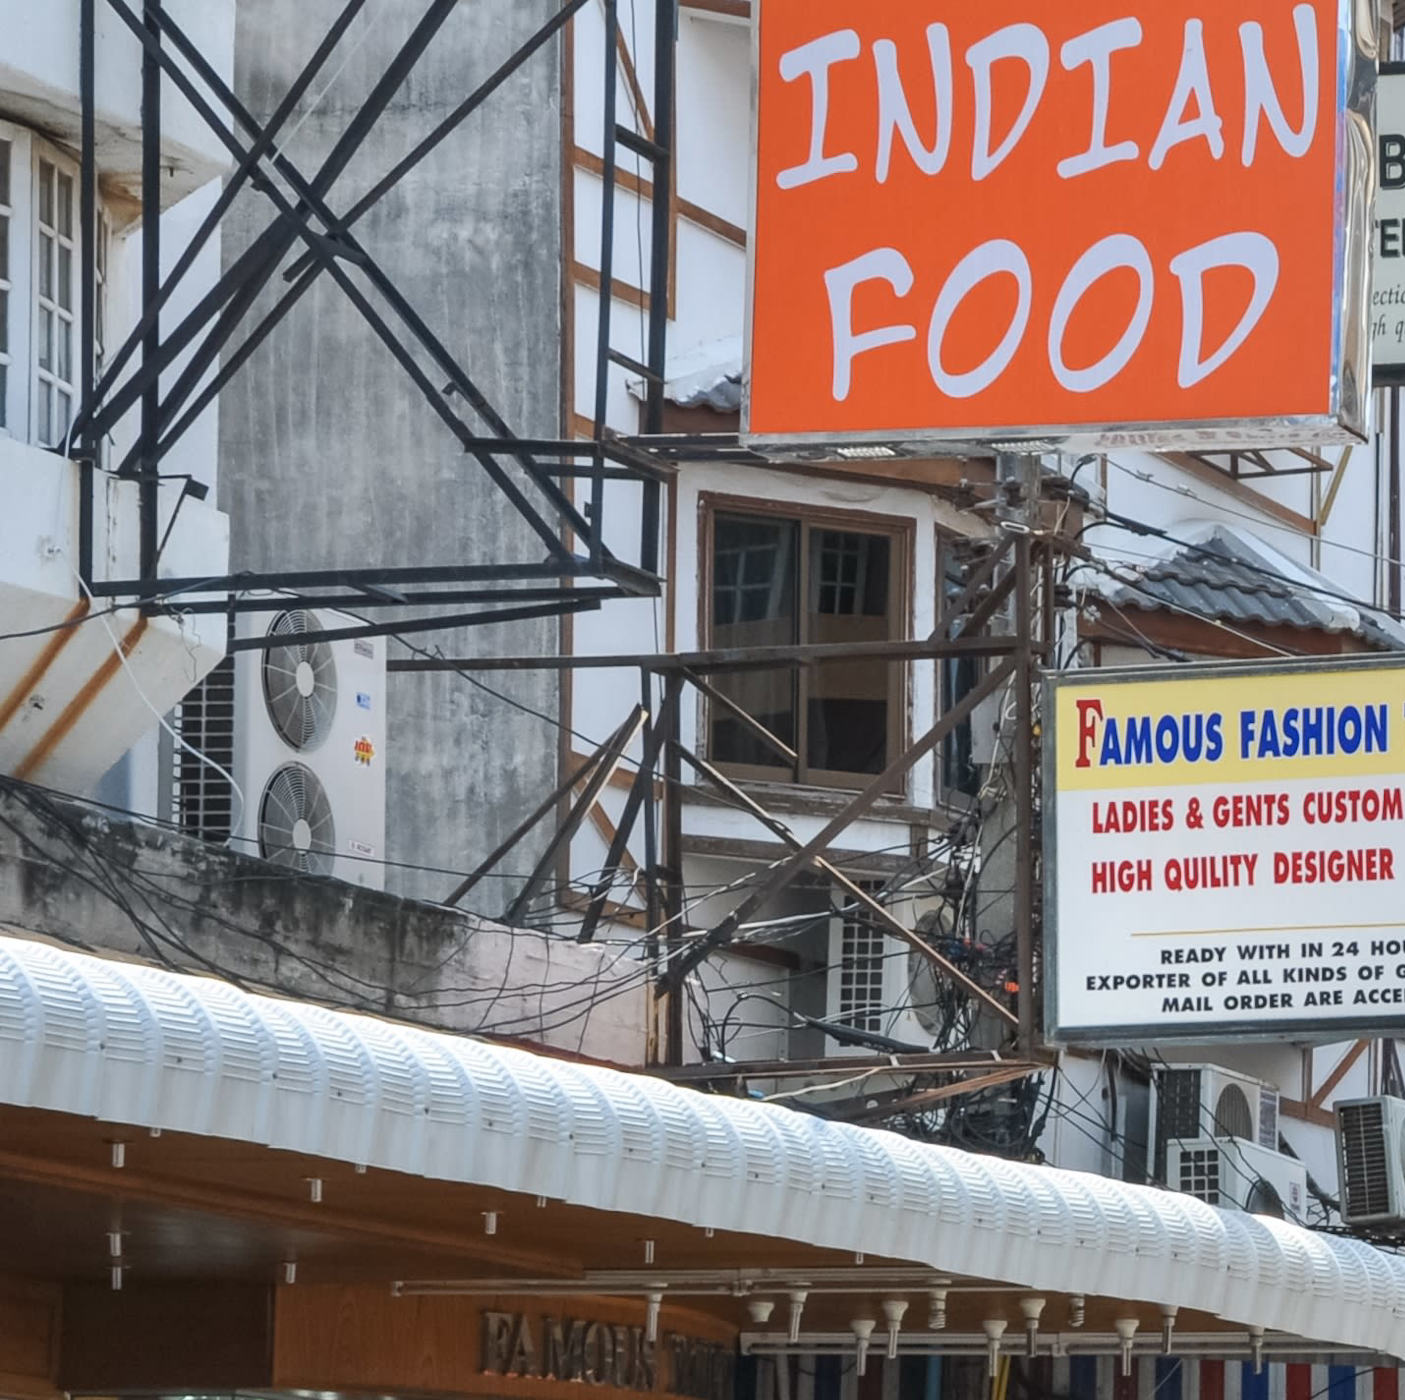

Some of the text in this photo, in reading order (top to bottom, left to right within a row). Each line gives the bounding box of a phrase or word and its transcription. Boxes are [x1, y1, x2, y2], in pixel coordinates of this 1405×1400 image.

[775, 2, 1319, 191] INDIAN
[823, 231, 1281, 402] FOOD
[1074, 699, 1224, 768] FAMOUS
[1240, 703, 1388, 760] FASHION
[1092, 799, 1174, 834] LADIES
[1186, 797, 1204, 829] &
[1213, 793, 1290, 827] GENTS
[1302, 788, 1403, 824] CUSTOM
[1092, 848, 1395, 894] HIGH QUILITY DESIGNER
[1161, 947, 1226, 965] READY
[1237, 944, 1290, 961] WITH
[1301, 942, 1324, 959] IN
[1331, 941, 1360, 957] 24
[1087, 972, 1190, 991] EXPORTER
[1202, 970, 1228, 988] OF
[1237, 969, 1272, 985] ALL
[1282, 966, 1348, 984] KINDS
[1358, 964, 1386, 981] OF
[1162, 995, 1214, 1013] MAIL
[1224, 992, 1293, 1010] ORDER
[1304, 989, 1343, 1006] ARE
